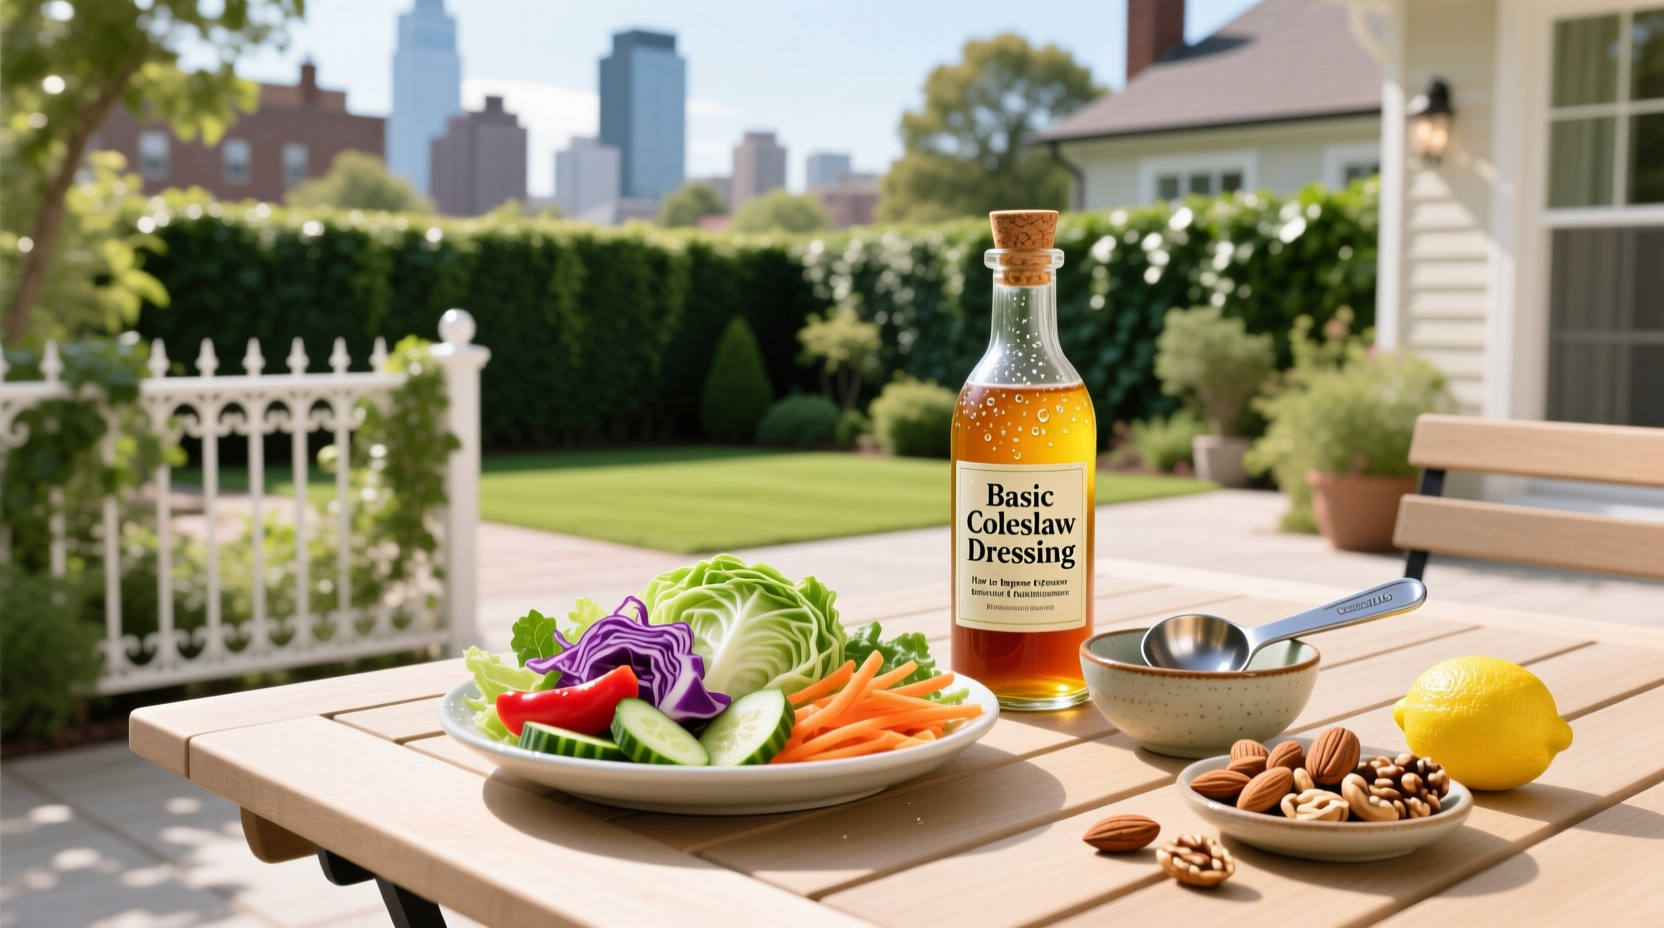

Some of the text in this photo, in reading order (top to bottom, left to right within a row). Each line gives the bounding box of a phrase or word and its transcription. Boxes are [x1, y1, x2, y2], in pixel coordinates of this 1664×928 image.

[986, 483, 1054, 507] Basic
[967, 510, 1076, 536] Coleslaw
[967, 538, 1076, 569] Dressing
